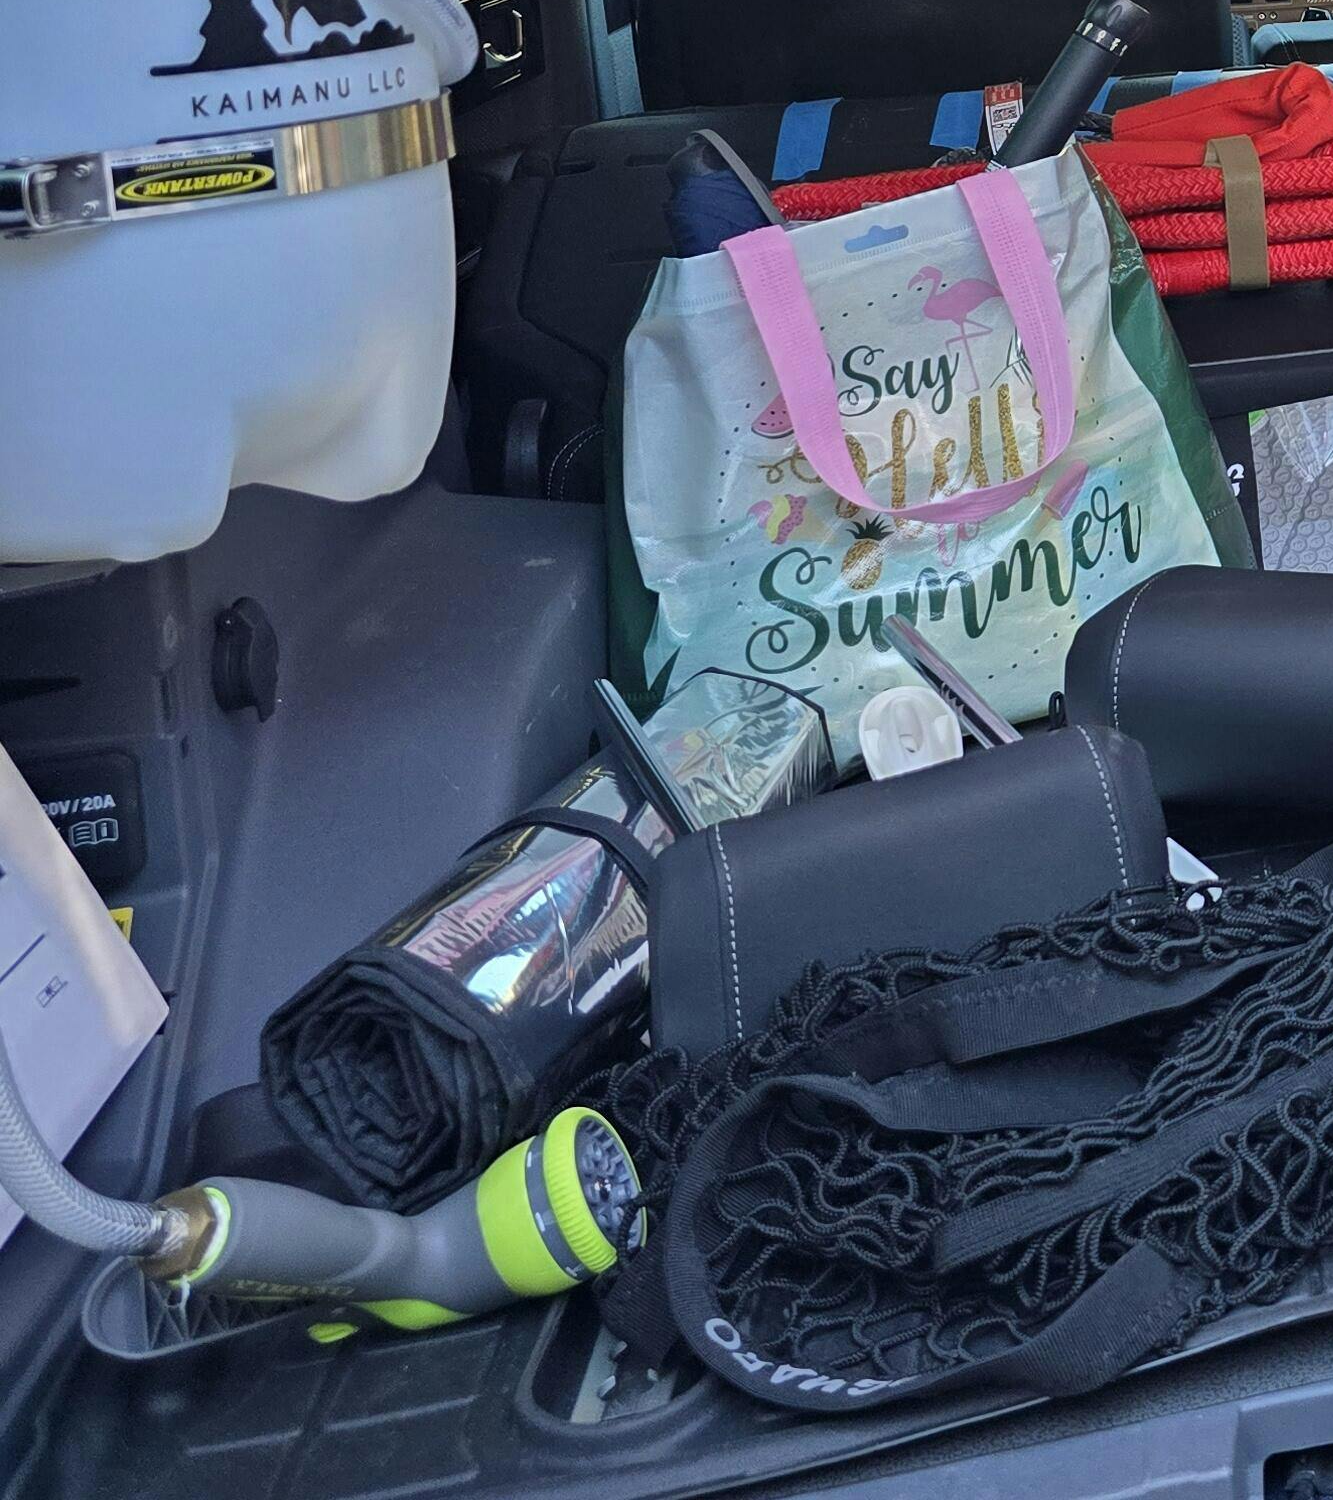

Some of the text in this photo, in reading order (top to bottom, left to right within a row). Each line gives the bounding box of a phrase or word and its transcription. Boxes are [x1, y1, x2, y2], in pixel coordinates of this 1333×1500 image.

[191, 66, 406, 118] KAIMANU LLC
[143, 169, 255, 196] POWERTANK
[838, 344, 960, 415] Say
[745, 486, 1142, 675] Summer
[82, 794, 116, 811] 20A
